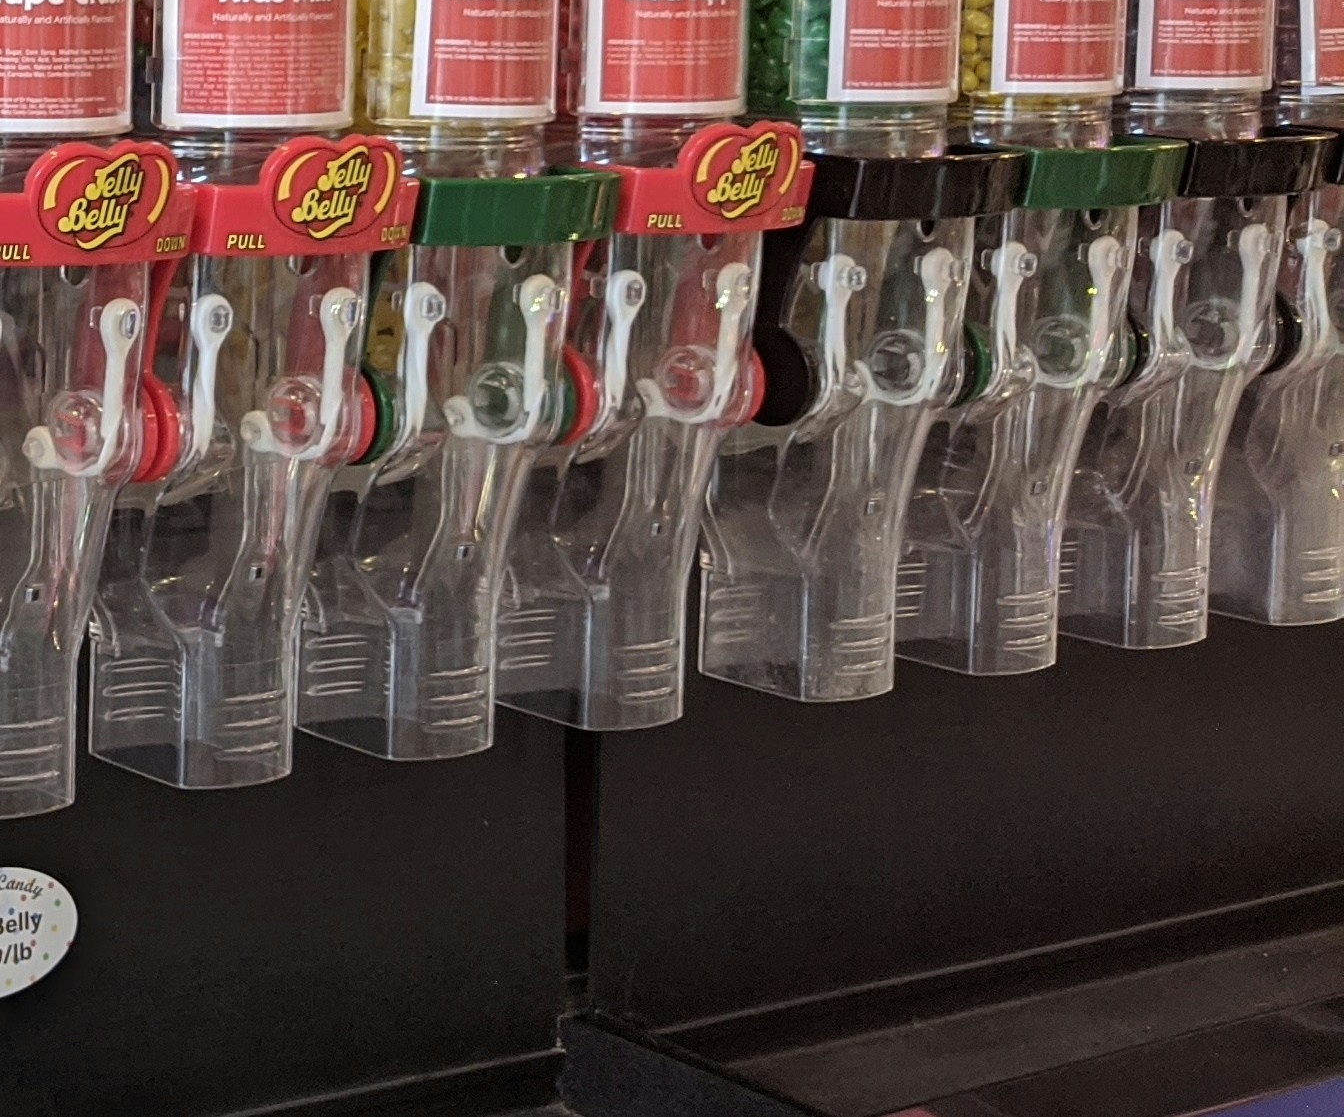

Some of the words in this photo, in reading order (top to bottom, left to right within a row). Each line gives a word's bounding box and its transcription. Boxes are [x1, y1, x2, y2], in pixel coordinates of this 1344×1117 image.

[34, 15, 52, 24] and
[212, 13, 253, 23] Naturally
[254, 13, 272, 22] and
[317, 145, 372, 196] Jelly
[733, 131, 780, 181] Jelly
[85, 152, 143, 206] Jelly
[708, 174, 765, 219] Belly
[57, 198, 131, 250] Belly
[226, 233, 265, 250] PULL
[380, 223, 406, 243] DOWN
[292, 189, 359, 239] Belly
[647, 213, 683, 229] PULL
[156, 233, 186, 253] DOWN
